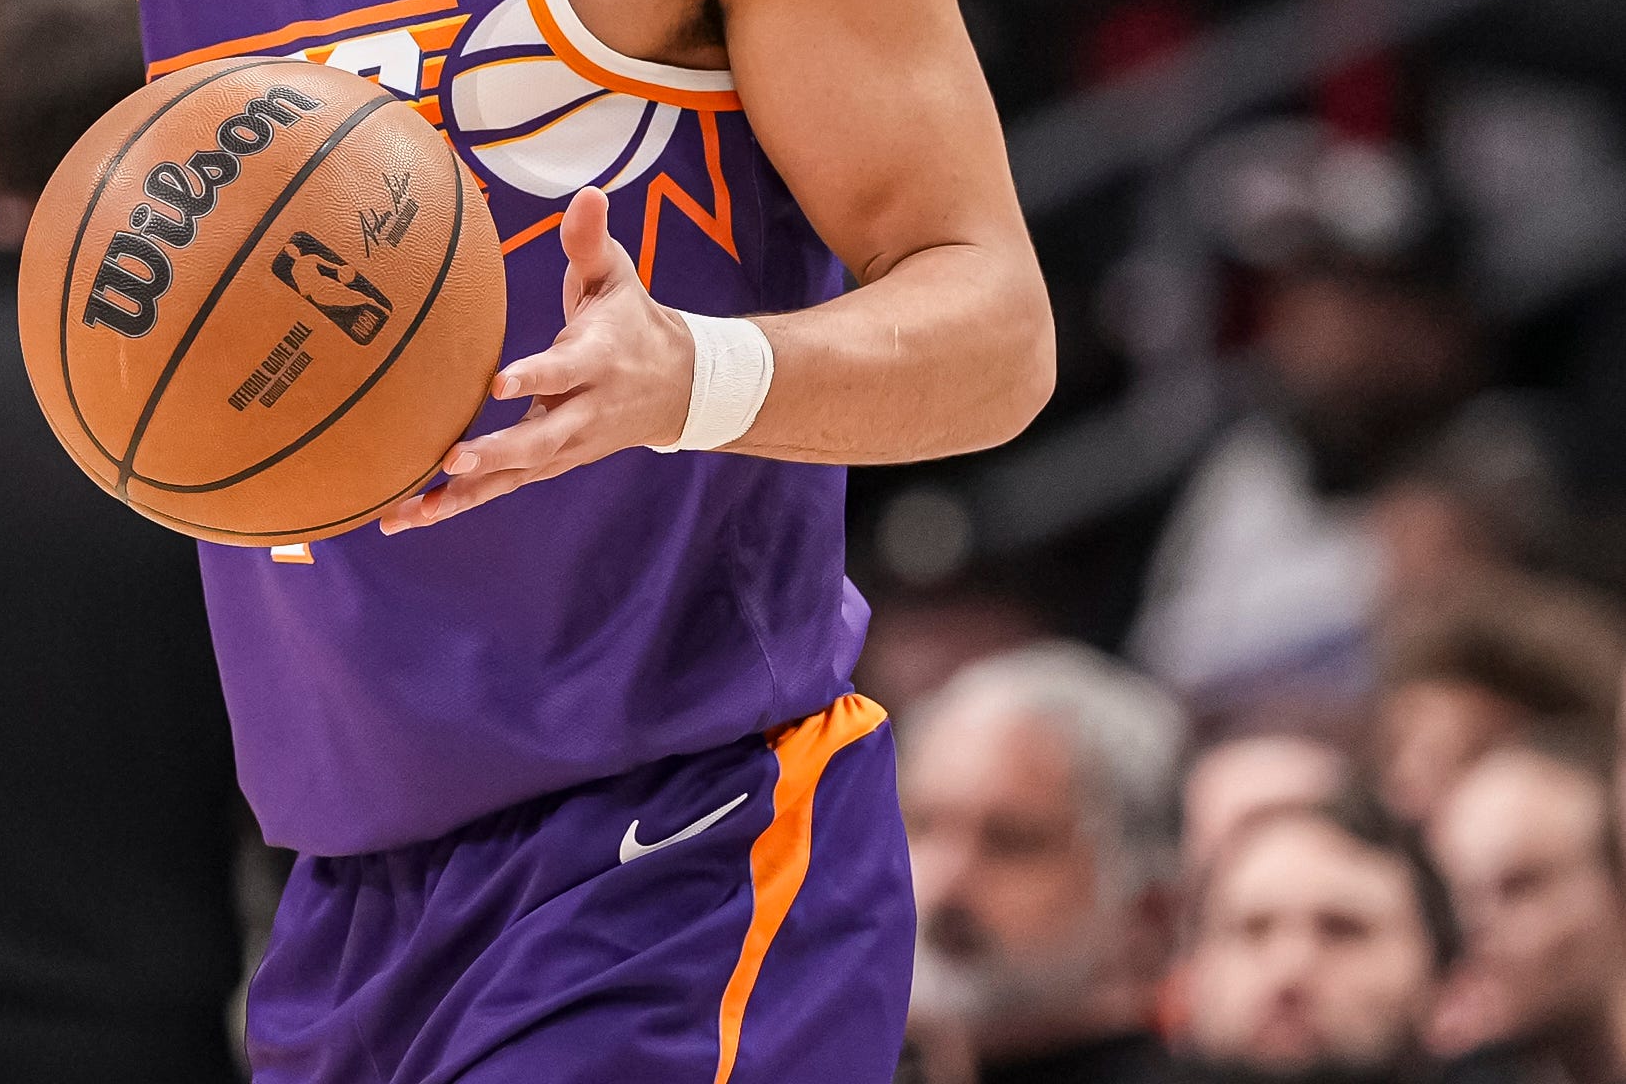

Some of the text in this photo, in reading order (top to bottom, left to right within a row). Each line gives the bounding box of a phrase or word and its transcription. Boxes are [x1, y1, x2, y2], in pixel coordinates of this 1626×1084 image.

[82, 83, 326, 340] Wilson
[351, 309, 379, 340] NBA
[227, 320, 314, 412] OFFICIAL GAME BALL
[258, 351, 314, 408] GENUINE LEATHER
